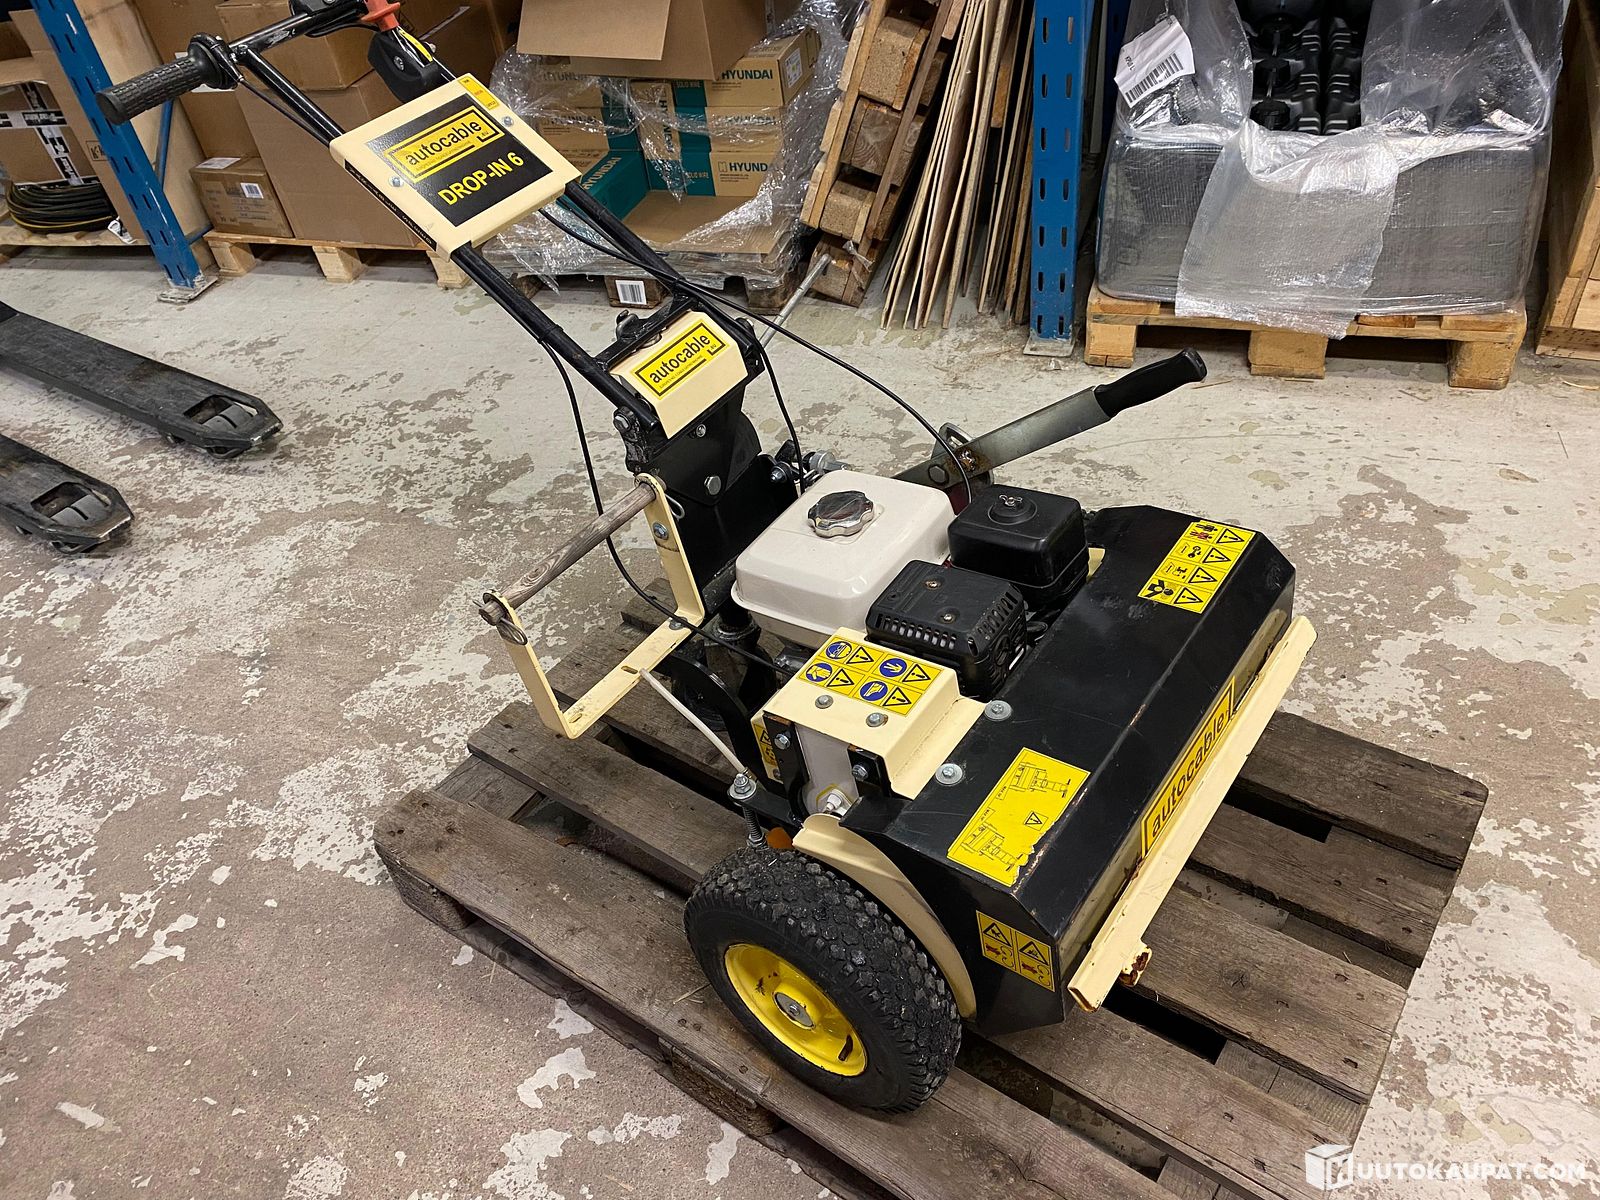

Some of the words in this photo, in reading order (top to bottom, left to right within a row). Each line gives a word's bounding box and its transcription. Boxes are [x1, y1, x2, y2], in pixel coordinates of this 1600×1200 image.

[721, 69, 773, 80] HYUNDAI
[405, 121, 482, 166] autocable
[729, 162, 769, 172] HYUND
[437, 158, 513, 206] DROP-IN
[507, 152, 524, 166] 6
[649, 333, 711, 384] autocable
[1151, 712, 1225, 838] autocable
